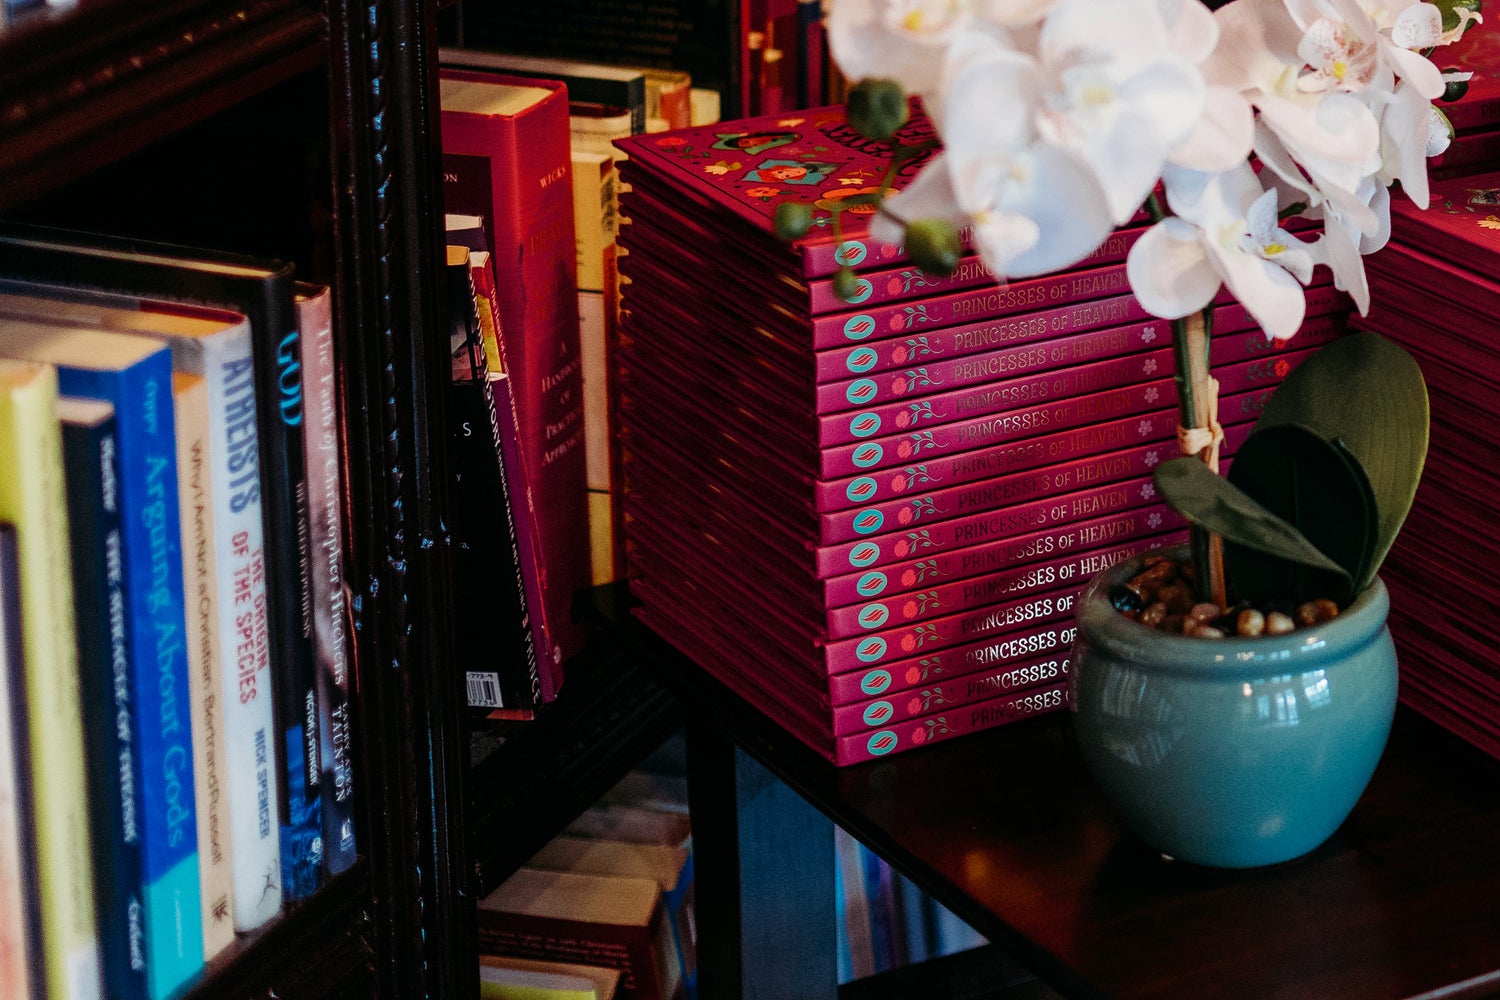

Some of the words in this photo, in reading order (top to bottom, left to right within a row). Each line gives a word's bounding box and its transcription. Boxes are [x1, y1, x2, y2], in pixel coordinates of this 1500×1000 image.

[952, 285, 1046, 319] PRINCESSES
[1050, 282, 1067, 300] OF
[1071, 270, 1128, 297] HEAVEN
[314, 319, 332, 368] The
[953, 316, 1047, 351] PRINCESSES
[1051, 314, 1067, 332] OF
[1071, 300, 1129, 328] HEAVEN
[275, 328, 304, 433] GOD
[952, 347, 1046, 382] PRINCESSES
[1050, 345, 1067, 362] OF
[1071, 332, 1128, 359] HEAVEN
[316, 372, 335, 433] Faith
[221, 352, 261, 516] ATHEISTS
[317, 429, 336, 456] of
[185, 436, 206, 497] Why
[957, 473, 1050, 510] PRINCESSES
[1054, 470, 1071, 489] OF
[1075, 455, 1131, 484] HEAVEN
[137, 450, 179, 618] Arguing
[318, 454, 343, 589] Christopher
[954, 506, 1046, 543] PRINCESSES
[1050, 502, 1067, 521] OF
[1071, 488, 1128, 516] HEAVEN
[963, 534, 1054, 572] PRINCESSES
[1058, 531, 1075, 551] OF
[1079, 517, 1135, 545] HEAVEN
[229, 528, 250, 562] OF
[248, 543, 265, 591] THE
[231, 562, 253, 610] THE
[960, 597, 1052, 636] PRINCESSES
[1056, 593, 1073, 613] OF
[193, 594, 217, 692] Christian
[233, 610, 258, 707] SPECIES
[251, 590, 270, 672] ORIGIN
[327, 586, 348, 688] Hitchens
[965, 630, 1056, 668] PRINCESSES
[1060, 626, 1078, 645] OF
[151, 615, 186, 741] About
[521, 629, 543, 707] PRINCE
[966, 659, 1058, 699] PRINCESSES
[970, 688, 1061, 728] PRINCESSES
[252, 726, 268, 768] NICK
[329, 704, 346, 805] TAUNTON
[159, 739, 193, 850] Gods
[253, 765, 272, 841] SPENCER
[205, 785, 227, 866] Russell
